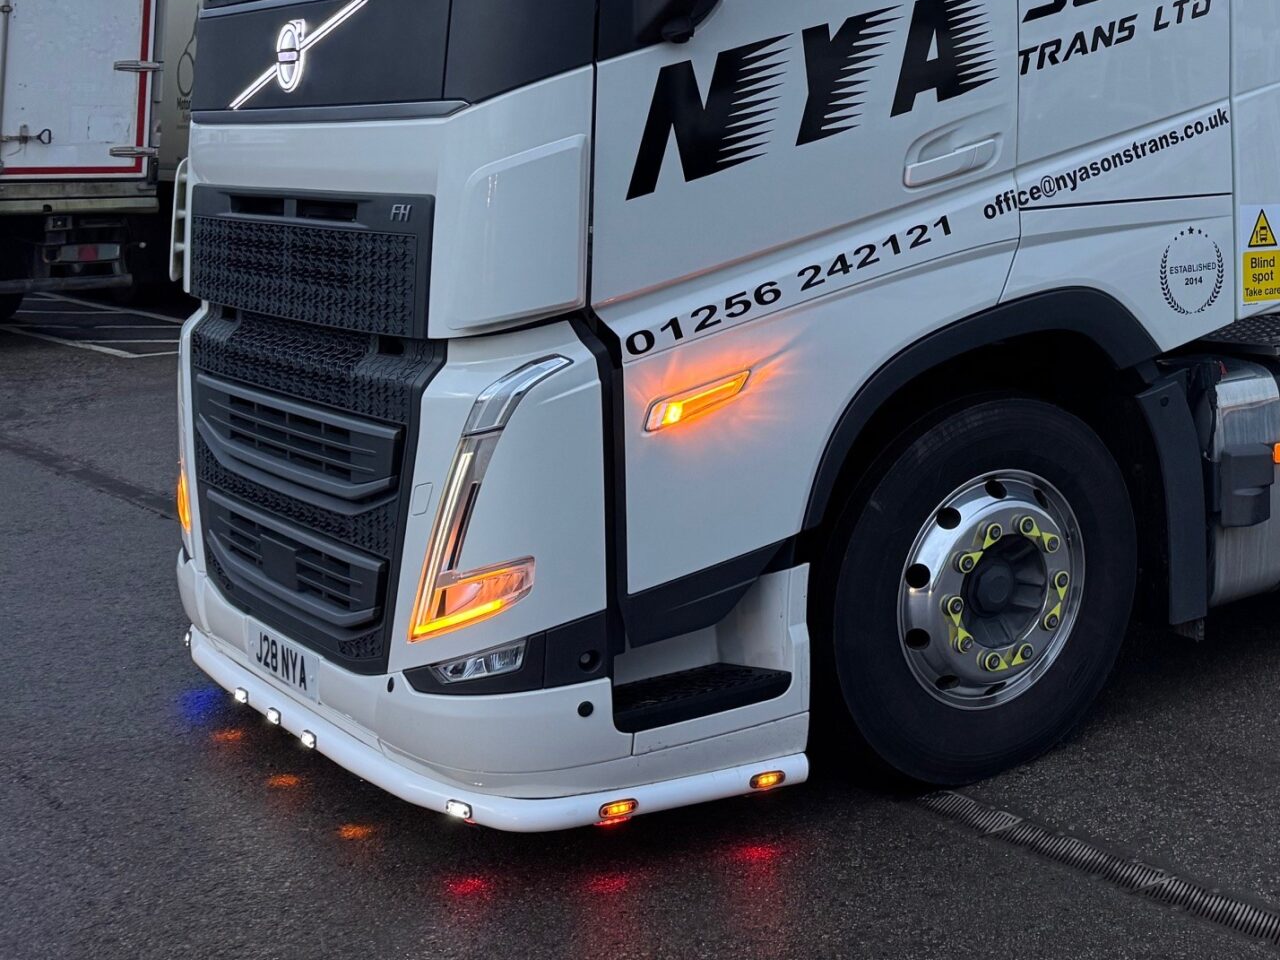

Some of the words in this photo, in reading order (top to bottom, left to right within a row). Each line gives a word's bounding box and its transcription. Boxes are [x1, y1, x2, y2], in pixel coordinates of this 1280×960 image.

[1018, 13, 1138, 76] TRANS
[983, 108, 1230, 220] office@nyasonstrans.co.uk
[390, 203, 412, 222] FH
[1169, 262, 1217, 275] ESTABLISHED
[1250, 256, 1275, 269] Blind
[625, 281, 782, 356] 01256
[797, 214, 952, 292] 242121
[1185, 276, 1203, 286] 2014
[1252, 270, 1274, 284] spot
[1244, 287, 1263, 298] Take
[256, 631, 278, 673] J28
[281, 644, 307, 691] NYA
